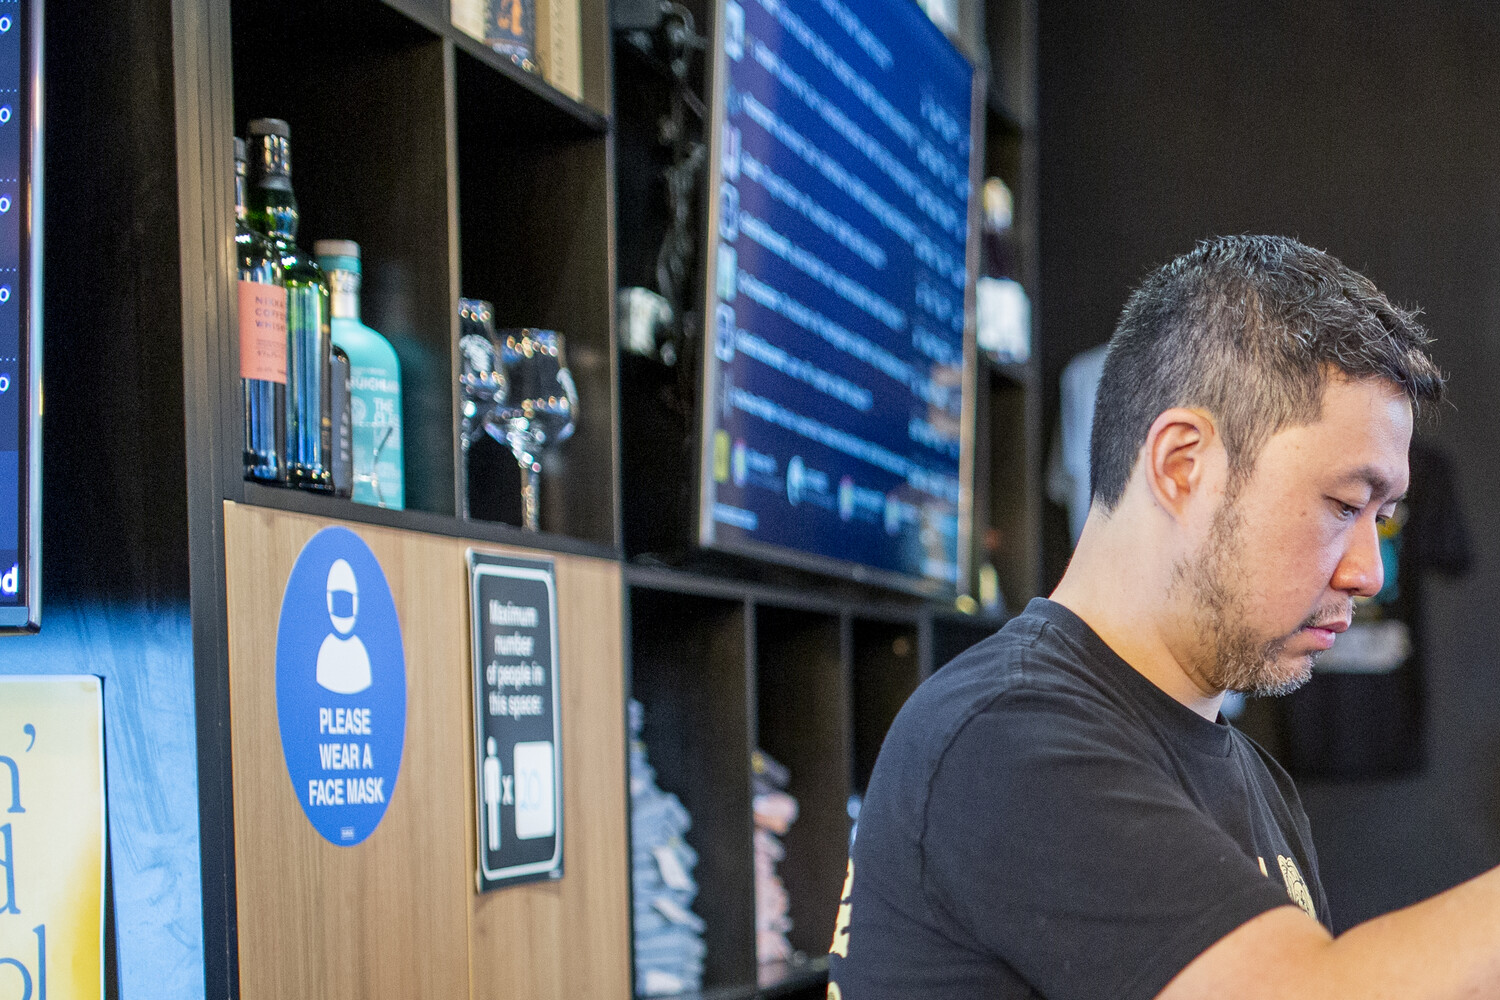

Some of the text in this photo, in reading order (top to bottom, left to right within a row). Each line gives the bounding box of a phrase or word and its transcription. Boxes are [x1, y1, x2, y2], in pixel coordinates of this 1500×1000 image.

[489, 599, 539, 628] Maximum
[494, 631, 534, 657] number
[486, 660, 546, 694] of people in
[489, 690, 508, 716] this
[319, 707, 371, 735] PLEASE
[319, 743, 374, 770] WEAR A
[308, 776, 385, 806] FACE MASK
